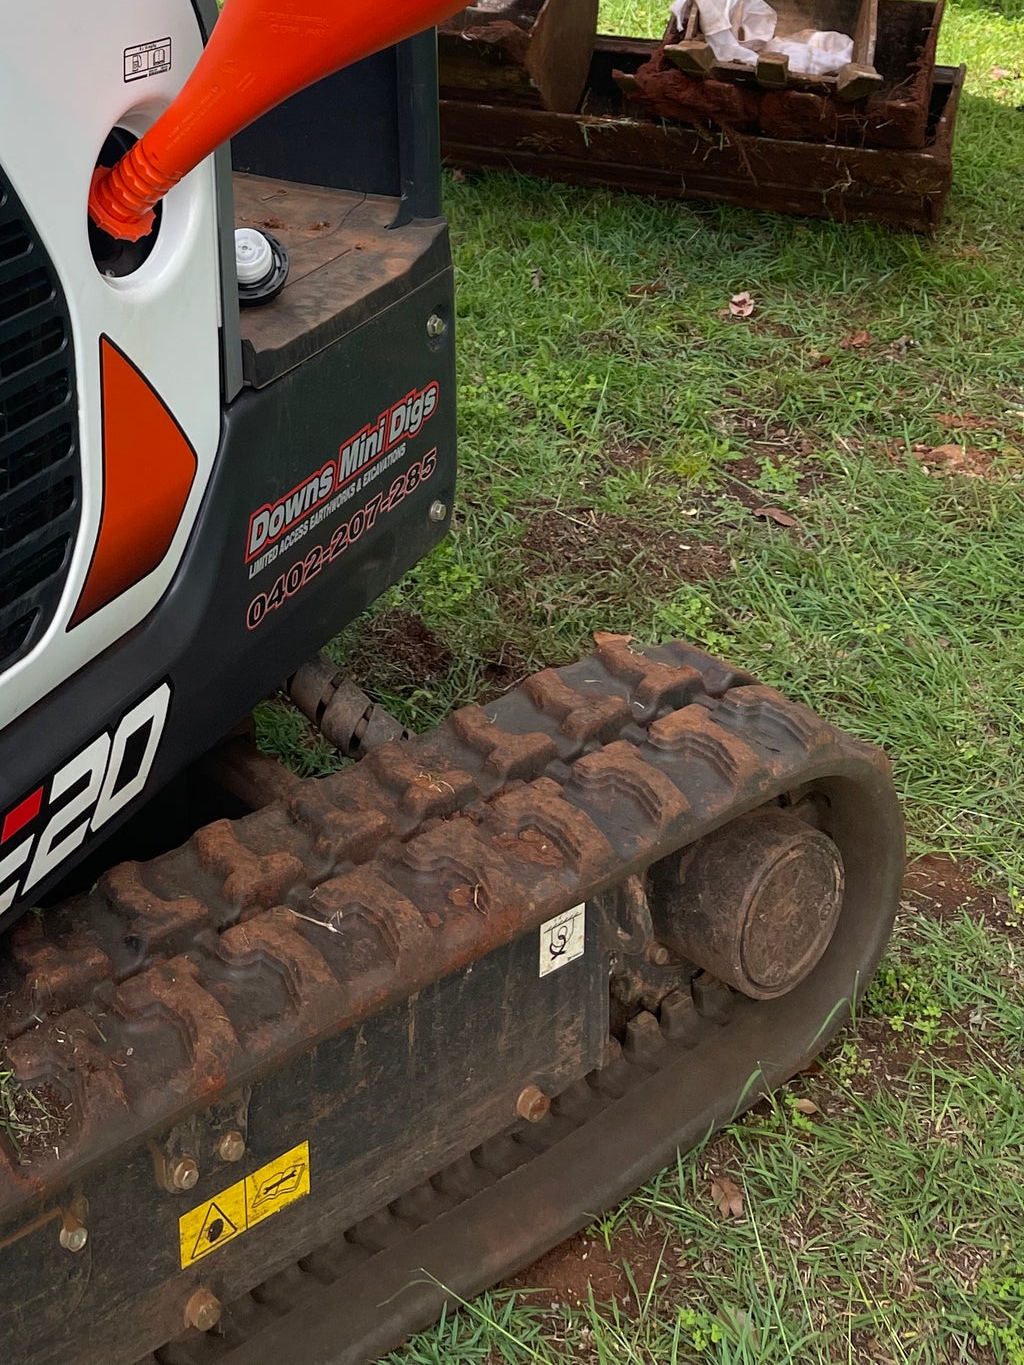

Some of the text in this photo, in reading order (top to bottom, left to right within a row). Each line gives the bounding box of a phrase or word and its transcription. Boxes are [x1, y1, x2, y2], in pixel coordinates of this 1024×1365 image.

[246, 446, 438, 630] 0402-207-285
[247, 384, 438, 559] Downs Mini Digs
[248, 442, 407, 580] LIMITED ACCESS EARTHWORKS & EXCAVATIONS
